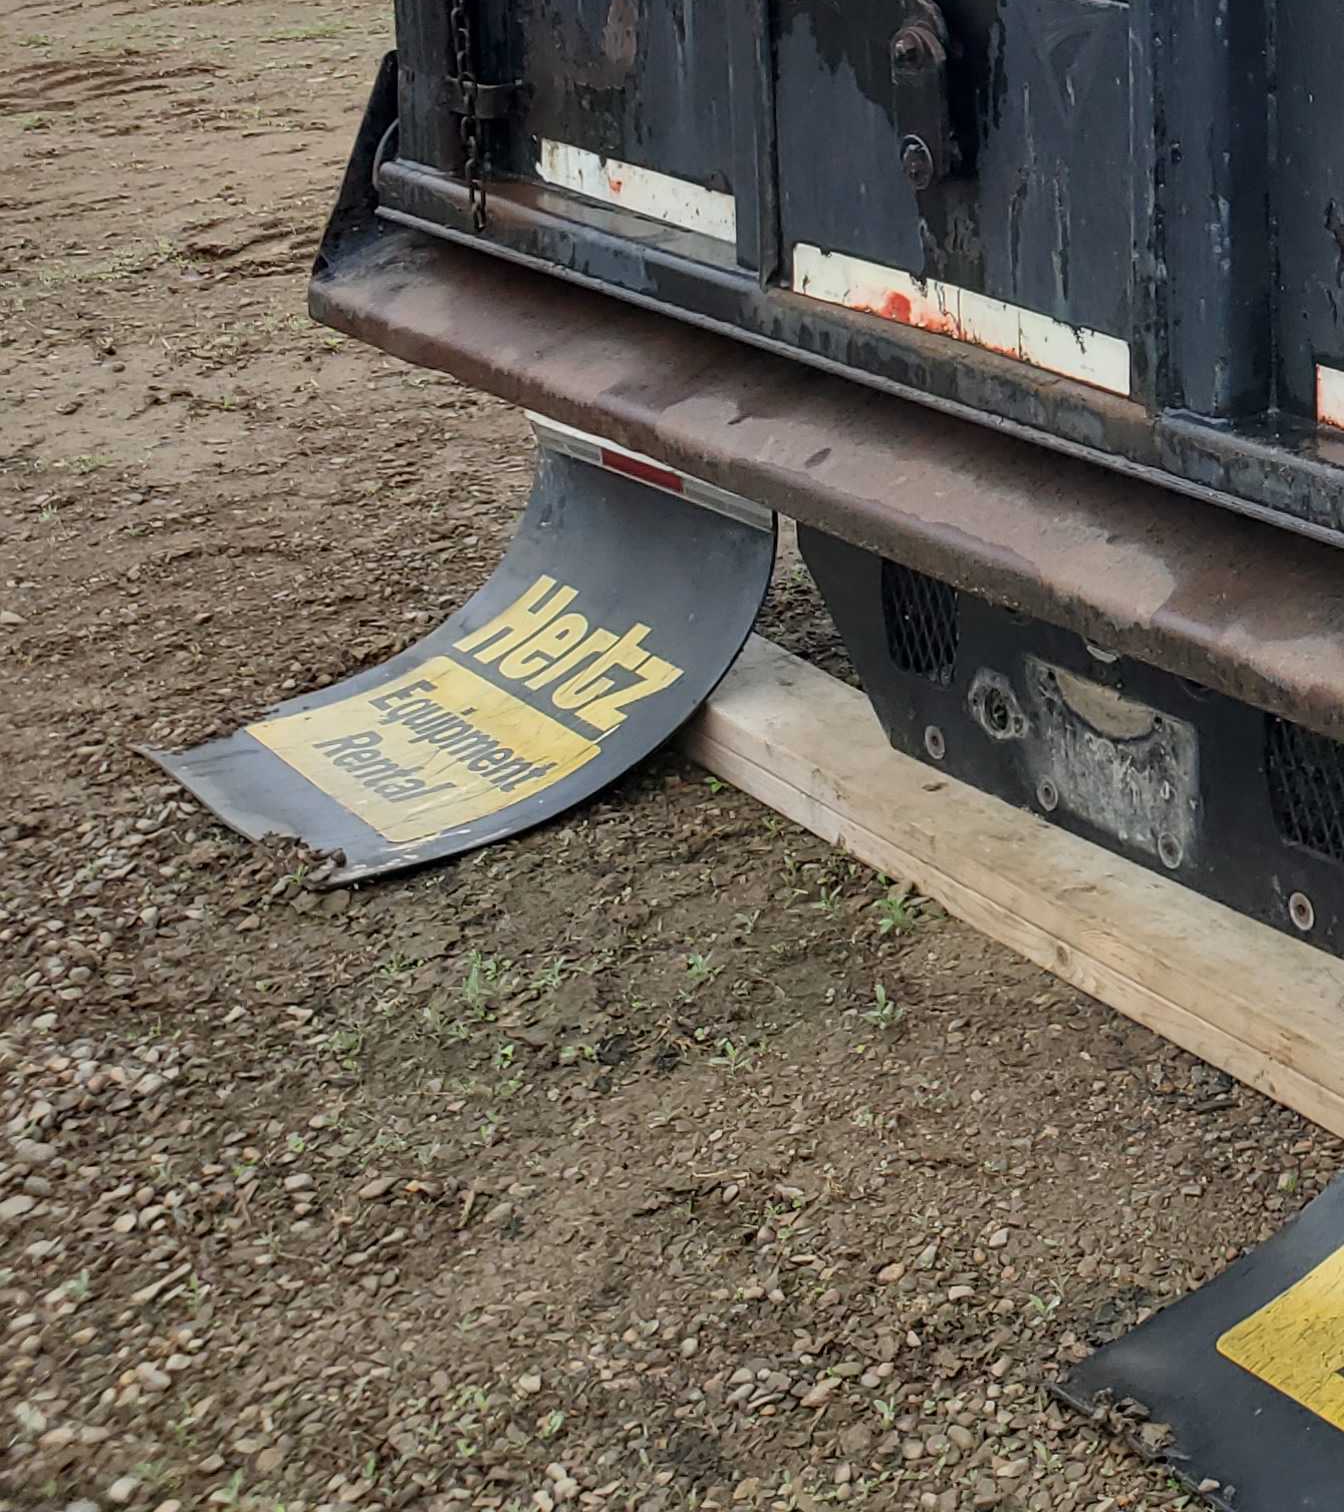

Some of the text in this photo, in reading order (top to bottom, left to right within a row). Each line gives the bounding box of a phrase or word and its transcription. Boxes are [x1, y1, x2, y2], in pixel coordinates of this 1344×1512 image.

[453, 574, 684, 732] Hertz
[312, 731, 457, 803] Rental
[368, 678, 559, 793] Equipment
